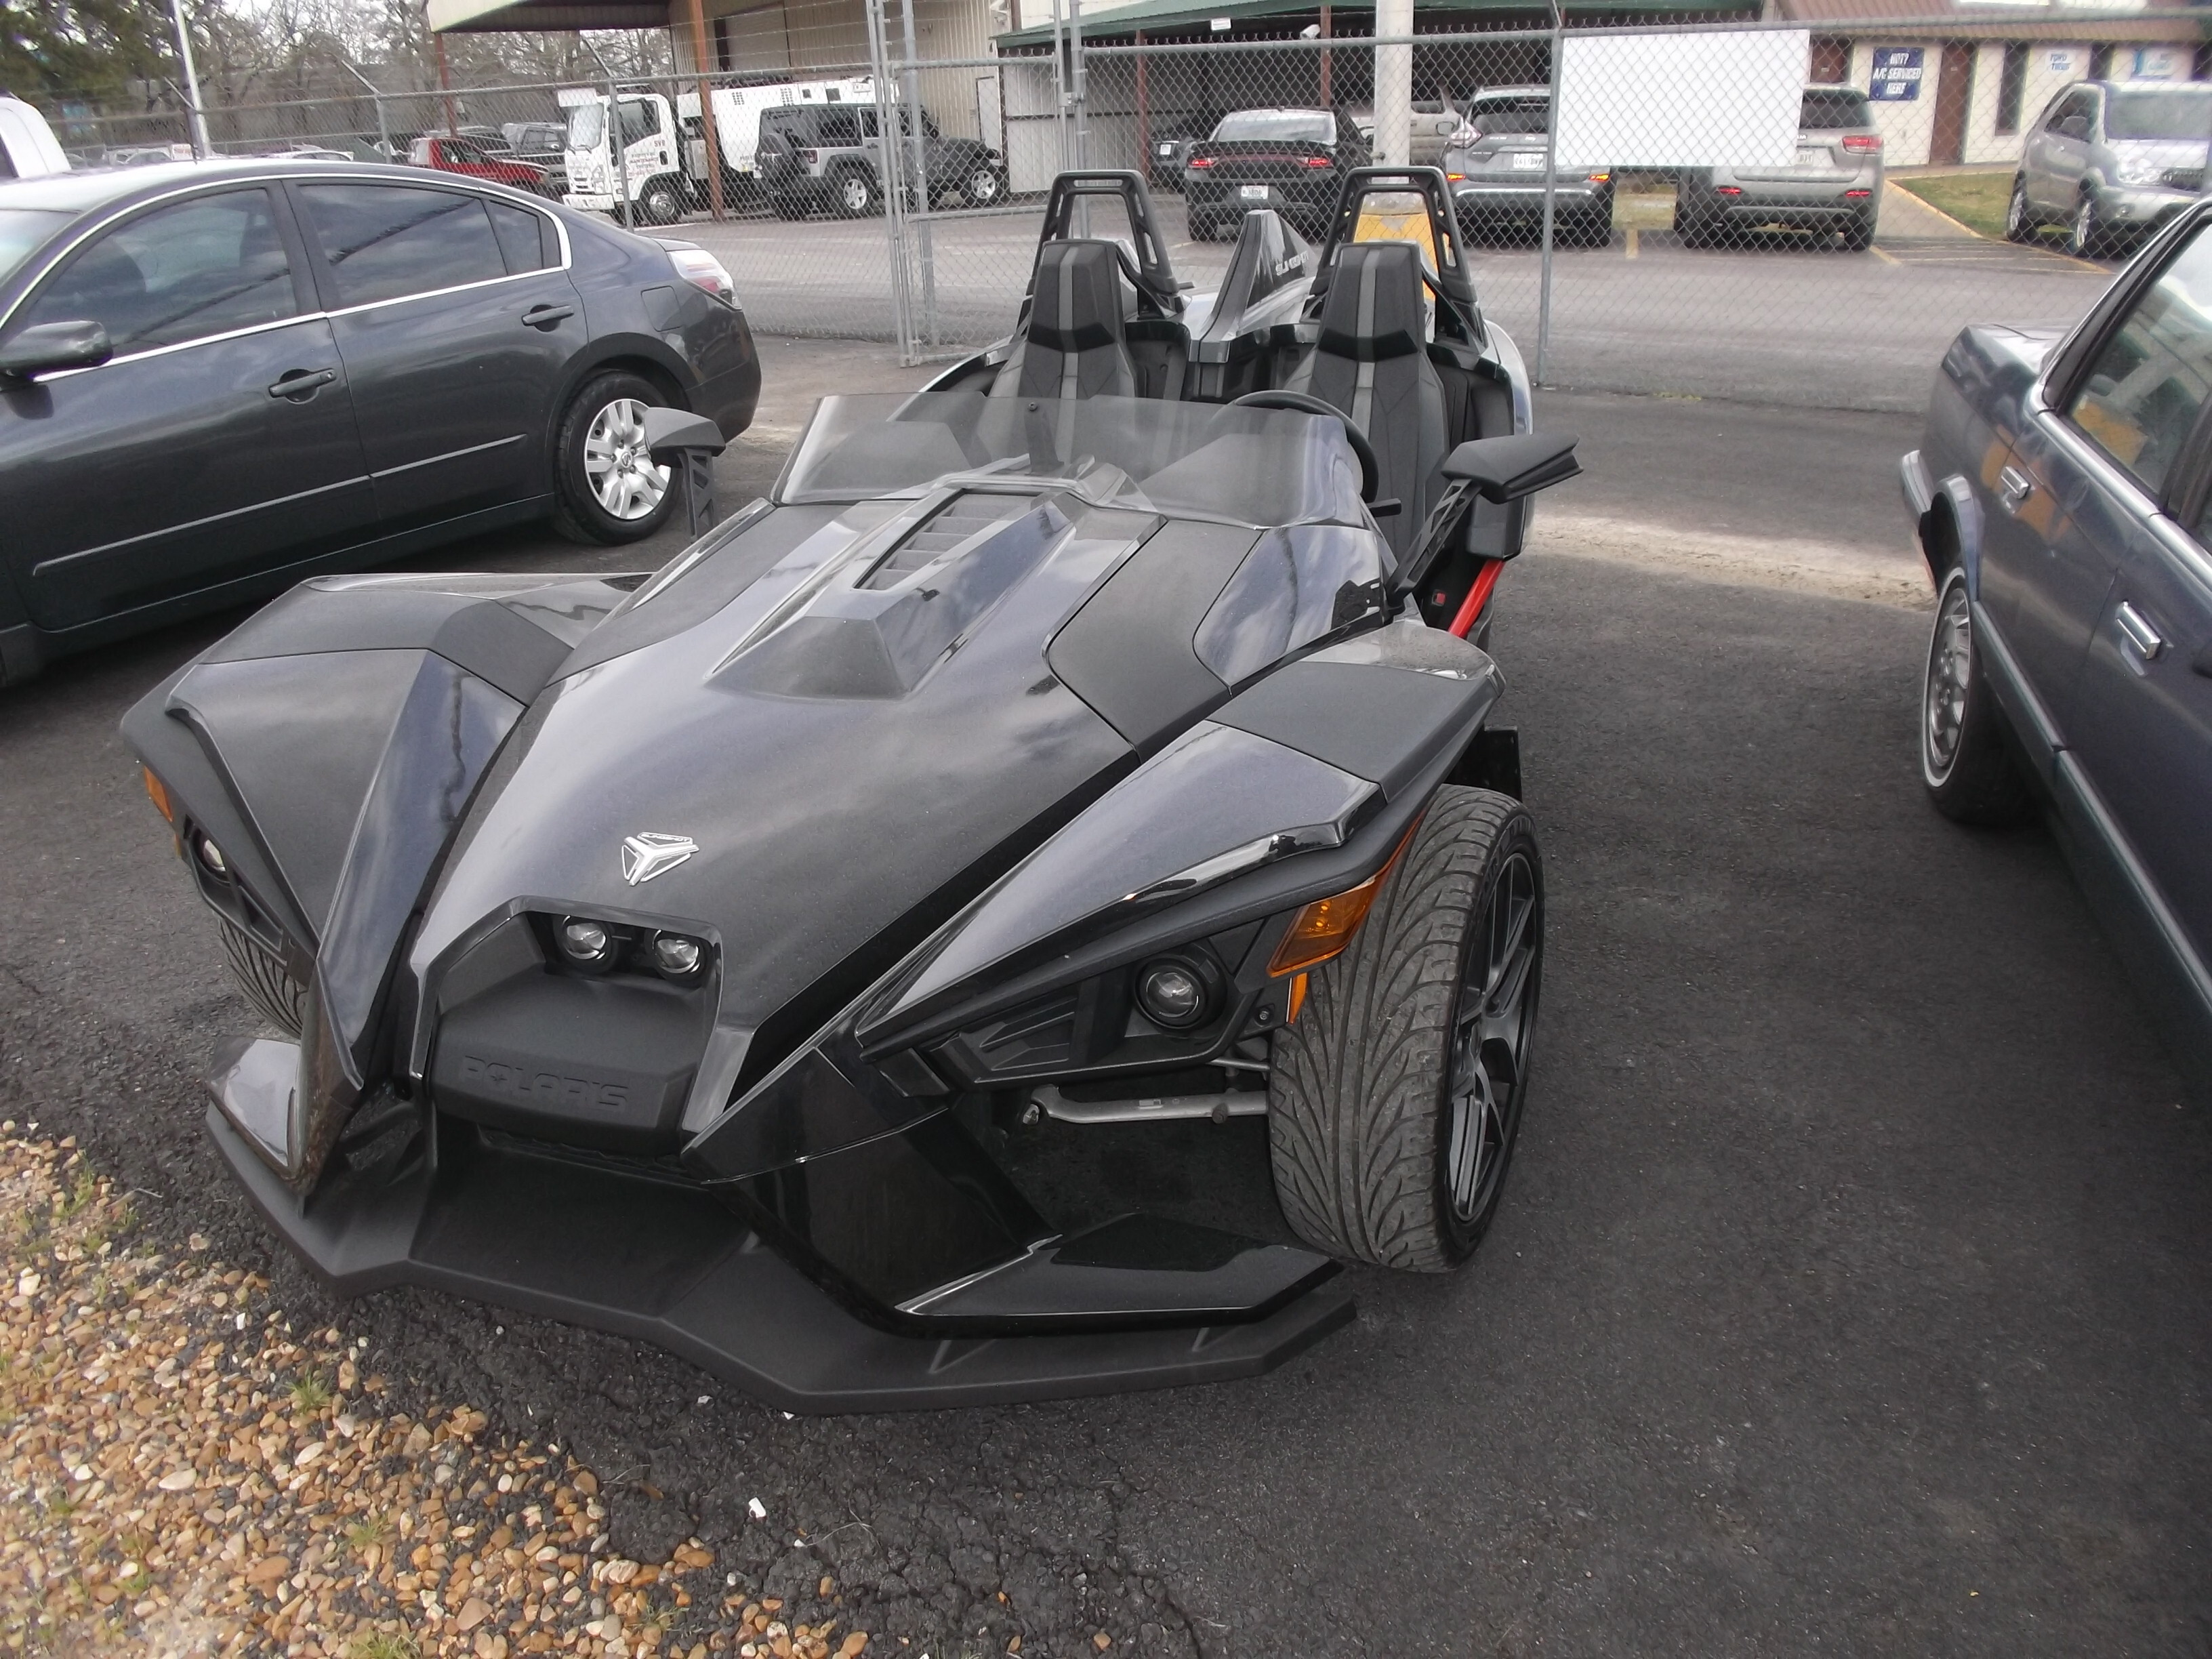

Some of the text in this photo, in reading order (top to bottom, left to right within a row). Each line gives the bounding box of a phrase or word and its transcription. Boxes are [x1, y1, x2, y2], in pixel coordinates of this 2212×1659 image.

[1872, 68, 1921, 79] A/C SERVICED
[1887, 82, 1906, 94] HERE
[462, 1054, 629, 1112] POLARIS
